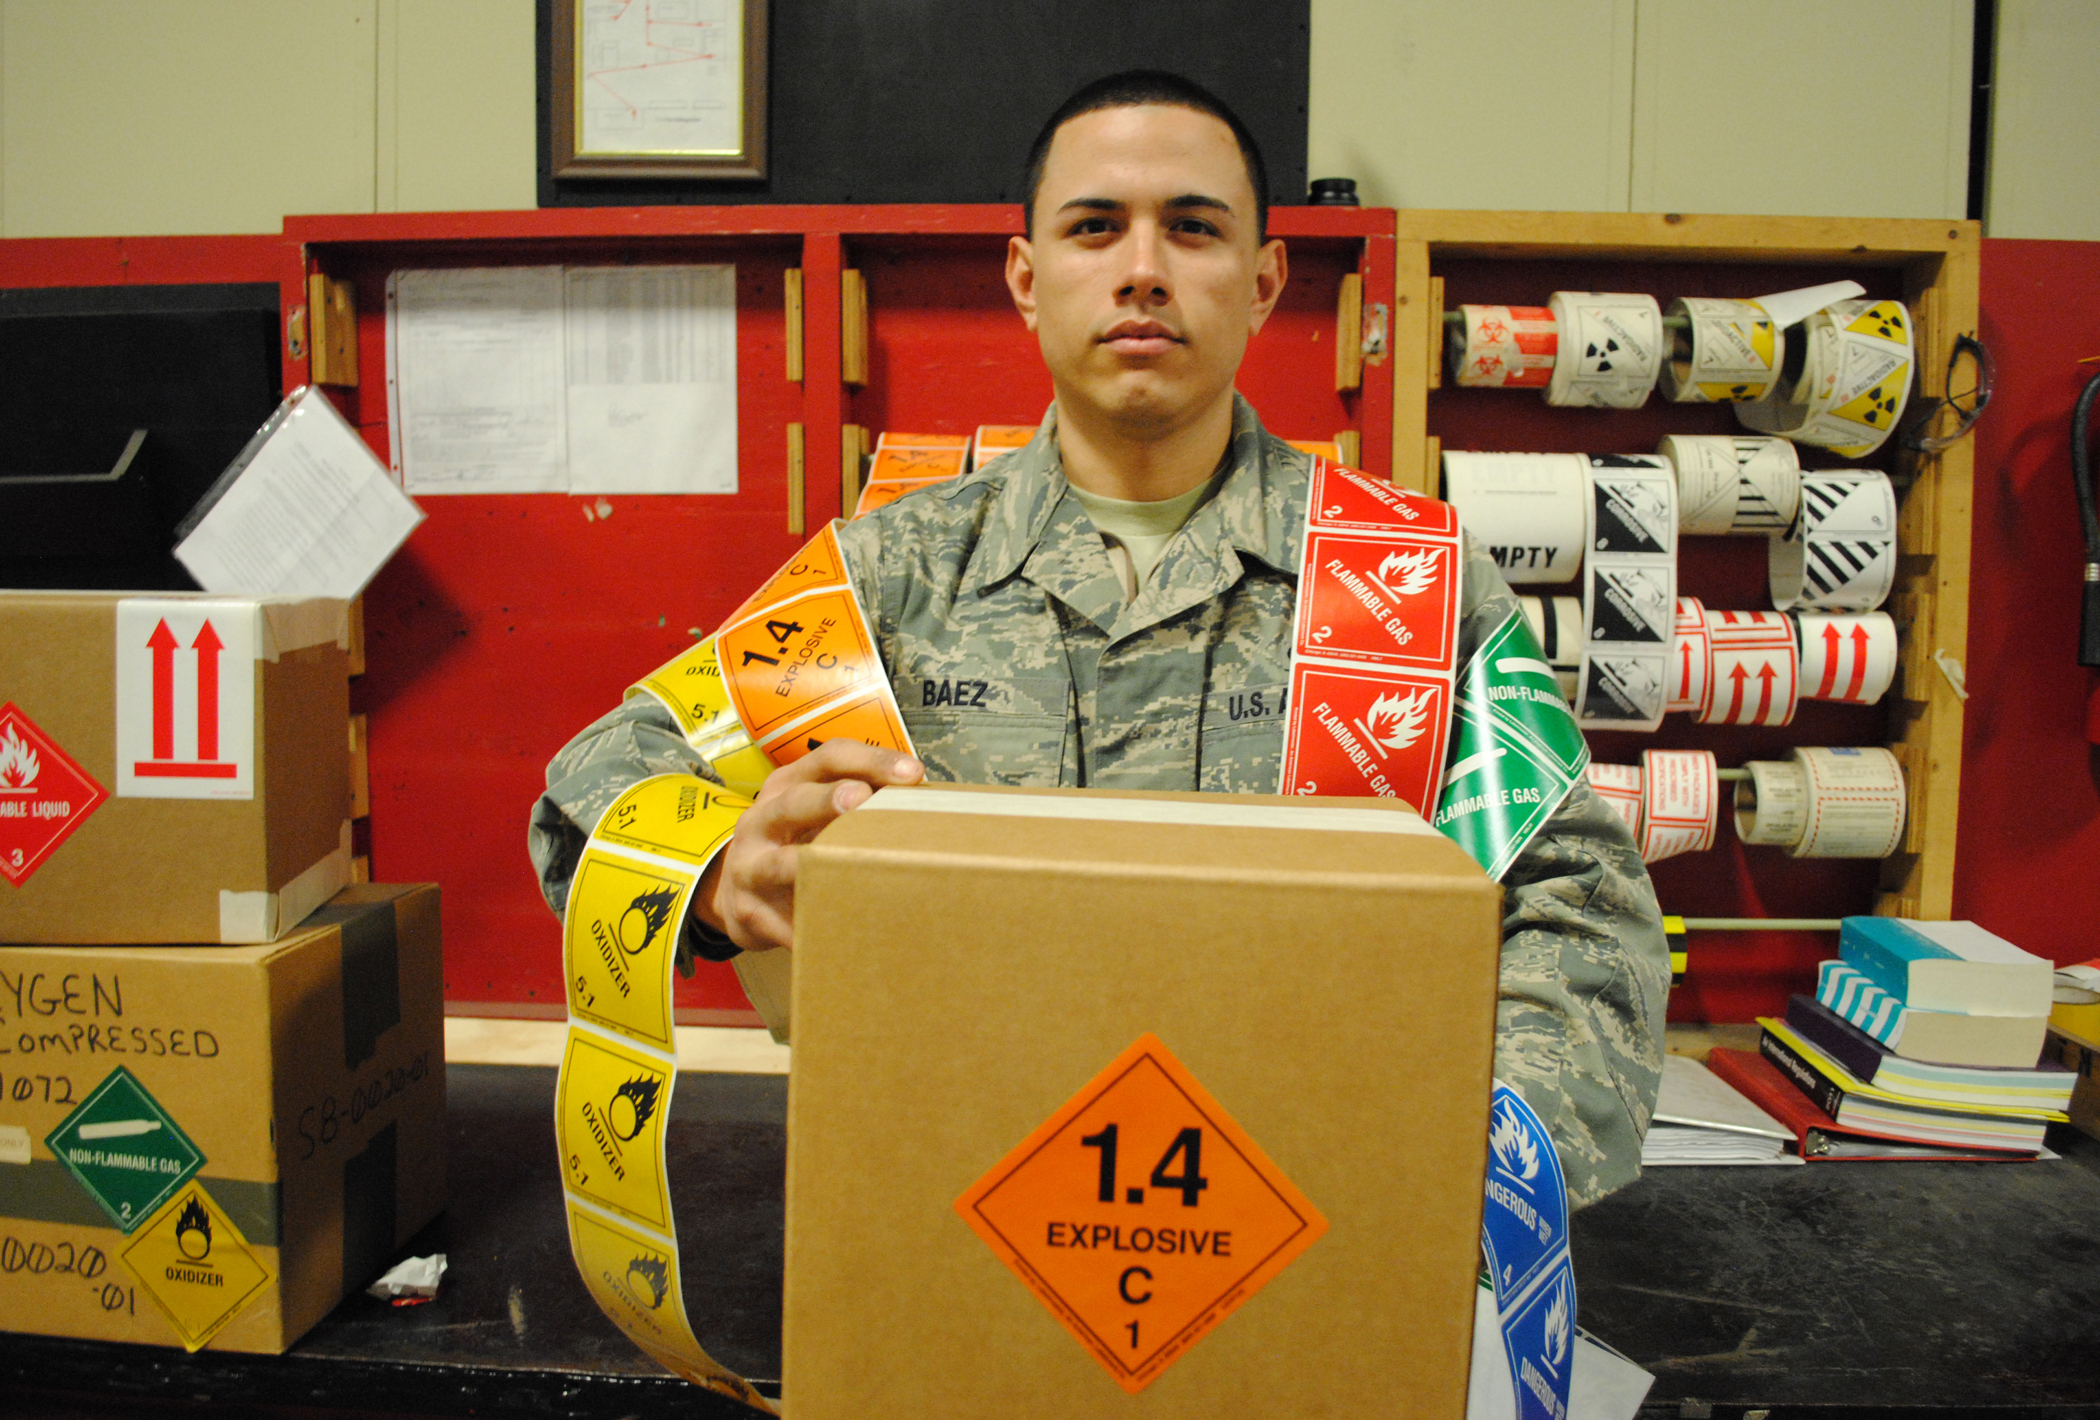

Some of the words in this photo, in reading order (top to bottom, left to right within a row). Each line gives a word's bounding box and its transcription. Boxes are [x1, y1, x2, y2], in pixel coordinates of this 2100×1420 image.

[1334, 467, 1399, 514] FLAMMABLE
[1391, 503, 1421, 522] GAS
[1323, 504, 1344, 519] 2
[1605, 498, 1649, 544] CORROSIVE
[789, 564, 808, 575] C
[1324, 558, 1384, 622] FLAMMABLE
[1385, 617, 1414, 647] GAS
[1604, 587, 1646, 633] CORROSIVE
[742, 618, 804, 668] 1.4
[1312, 625, 1333, 644] 2
[775, 617, 836, 698] EXPLOSIVE
[816, 652, 838, 670] C
[843, 664, 859, 675] 1
[922, 679, 988, 707] BAEZ
[1229, 694, 1270, 721] U.S.
[690, 703, 719, 724] 5.1
[1312, 702, 1374, 778] FLAMMABLE
[1369, 769, 1398, 800] GAS
[676, 785, 699, 823] OXIDIZER
[1297, 780, 1317, 796] 2
[33, 801, 70, 820] LIQUID
[617, 803, 637, 830] 5.1
[1435, 789, 1510, 827] FLAMMABLE
[1512, 787, 1541, 805] GAS
[12, 848, 24, 867] 3
[591, 919, 631, 998] OXIDIZER
[0, 970, 122, 1017] YGEN
[575, 976, 596, 1007] 5.1
[0, 1023, 220, 1058] OMPRESSED
[582, 1102, 625, 1182] OXIDIZER
[69, 1147, 158, 1172] NON-FLAMMABLE
[159, 1158, 181, 1175] GAS
[569, 1154, 589, 1187] 5.1
[1080, 1123, 1208, 1208] 1.4
[120, 1202, 132, 1219] 2
[1047, 1222, 1232, 1257] EXPLOSIVE
[166, 1266, 225, 1288] OXIDIZER
[1118, 1266, 1153, 1305] C
[1502, 1264, 1513, 1287] 4
[1124, 1320, 1139, 1349] 1
[1520, 1356, 1556, 1416] DANGEROUS
